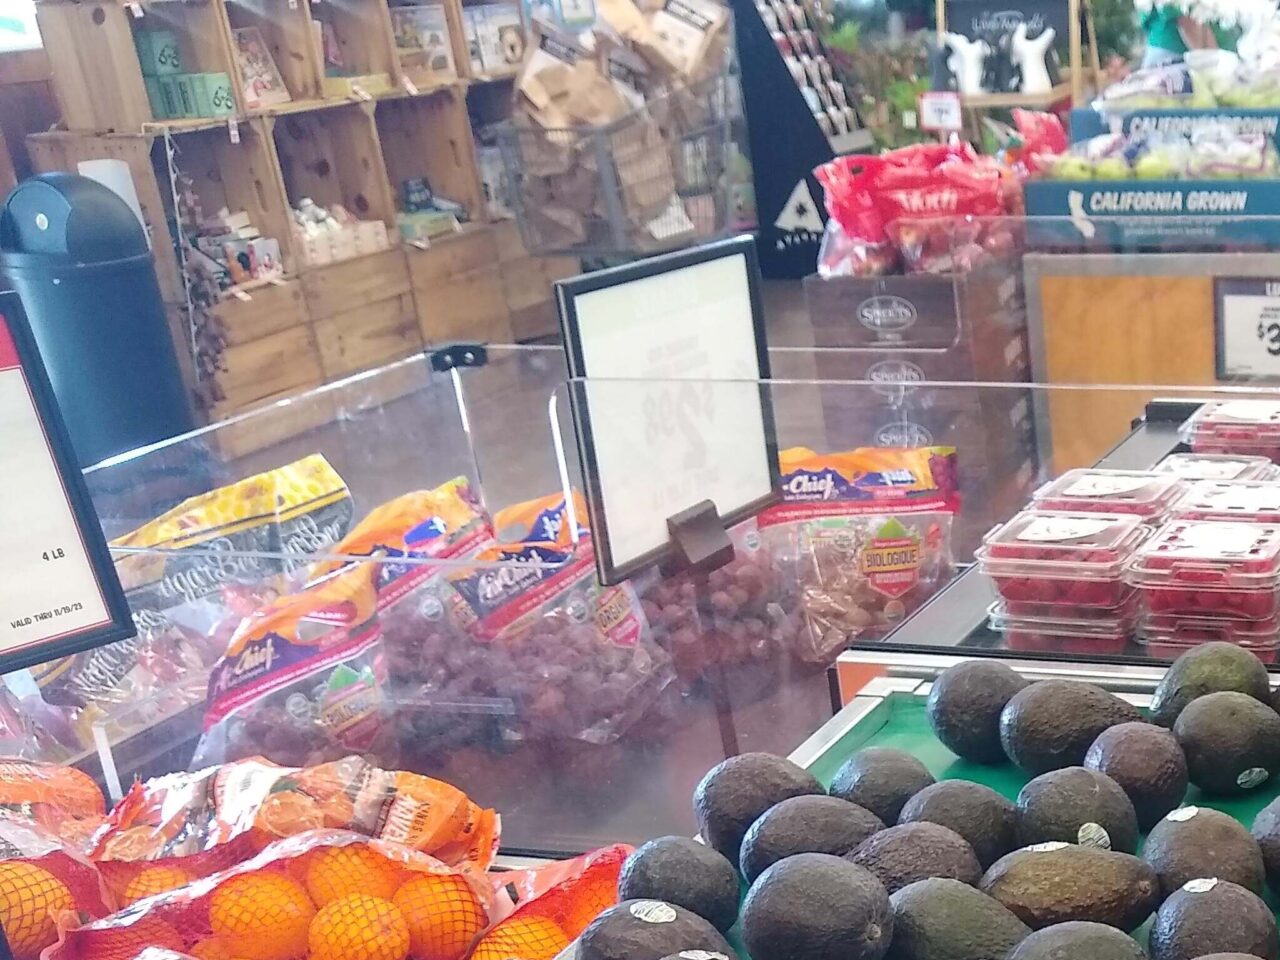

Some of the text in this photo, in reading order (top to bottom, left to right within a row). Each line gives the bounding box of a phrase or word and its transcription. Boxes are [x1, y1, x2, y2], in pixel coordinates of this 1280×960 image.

[1090, 191, 1248, 211] CALIFORNIA GROWN
[42, 547, 65, 562] 4 LB
[866, 549, 918, 569] BIOLOGIQUE
[10, 616, 33, 630] VALID
[33, 610, 53, 623] THRU
